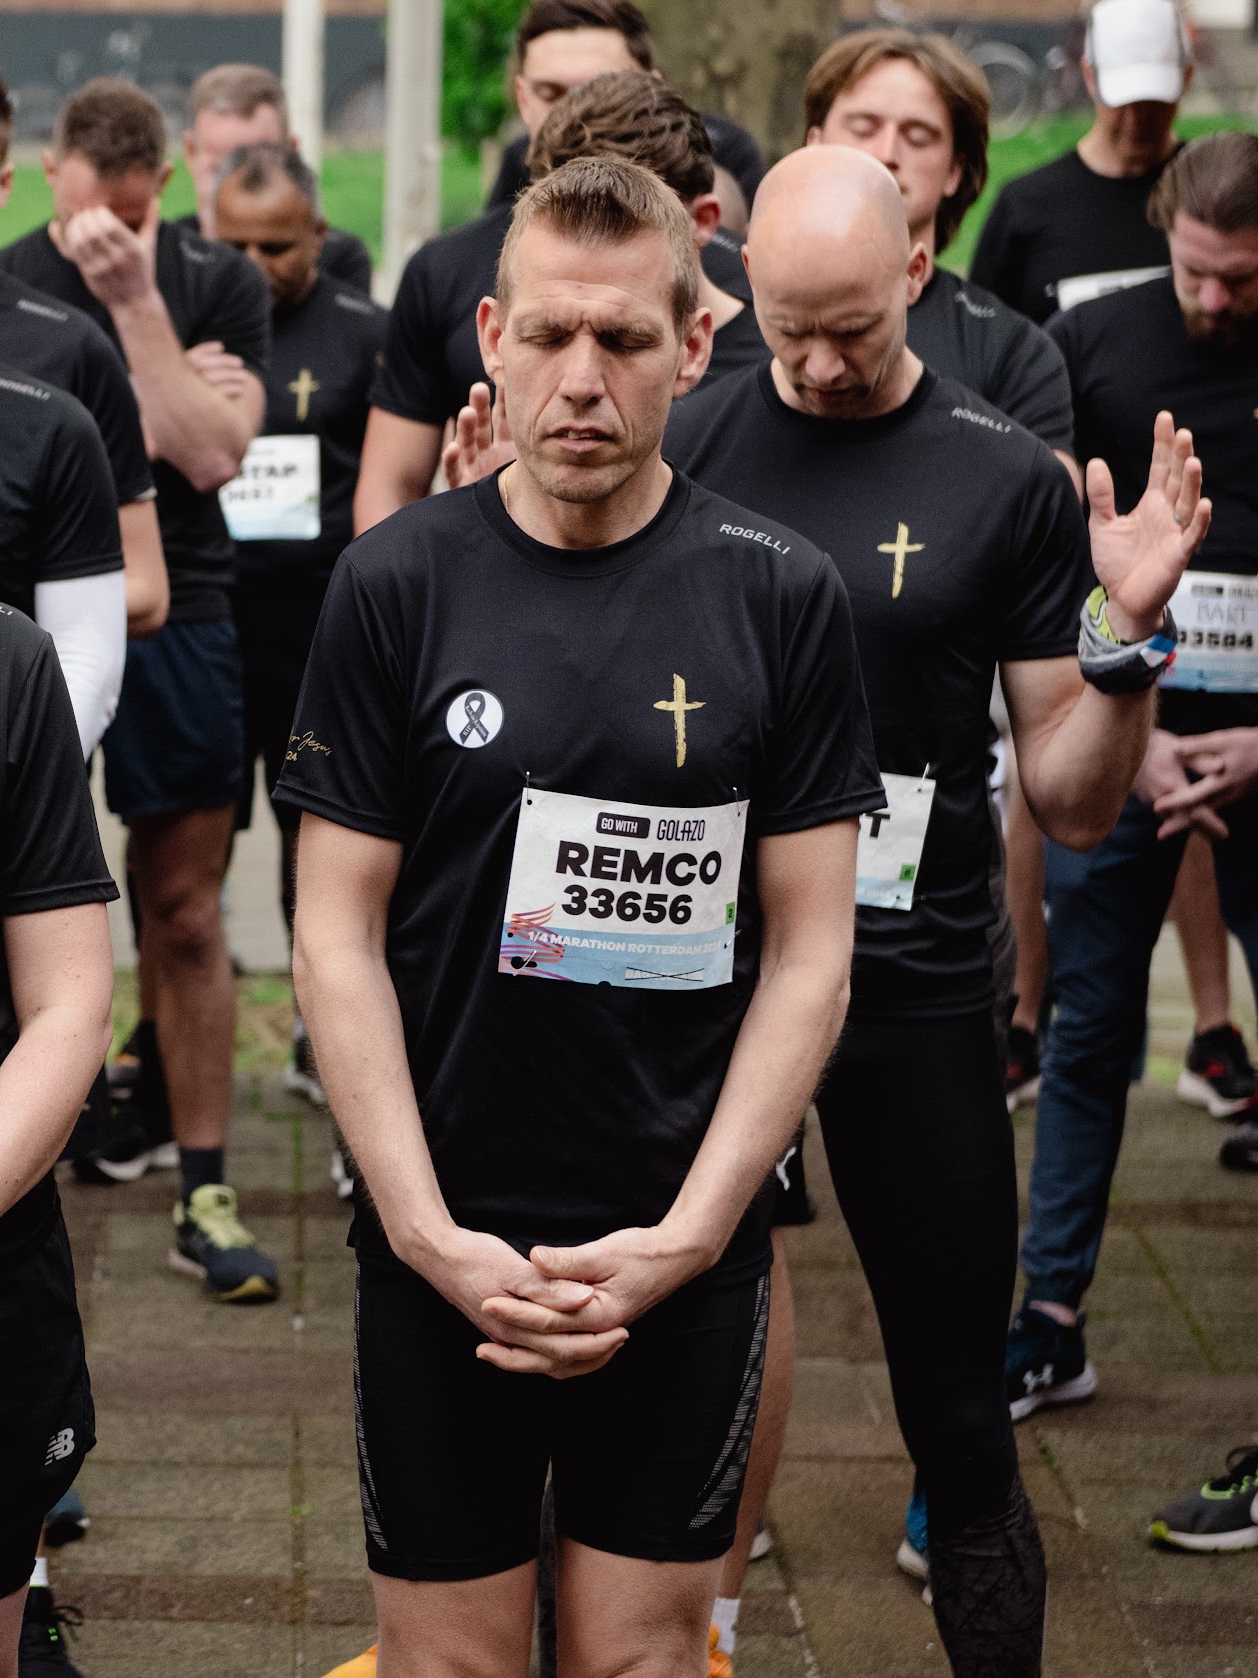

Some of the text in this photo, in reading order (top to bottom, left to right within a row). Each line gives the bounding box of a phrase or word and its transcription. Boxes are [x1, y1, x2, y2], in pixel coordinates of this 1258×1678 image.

[951, 407, 1012, 434] ROGELLI
[719, 523, 791, 555] ROGELLI
[297, 730, 333, 757] Jesus
[601, 817, 706, 842] GO WITH GOLAZO
[555, 839, 722, 887] REMCO
[561, 884, 693, 925] 33656
[528, 930, 548, 943] 1/4
[549, 934, 627, 953] MARATHON
[627, 942, 702, 956] ROTTERDAM
